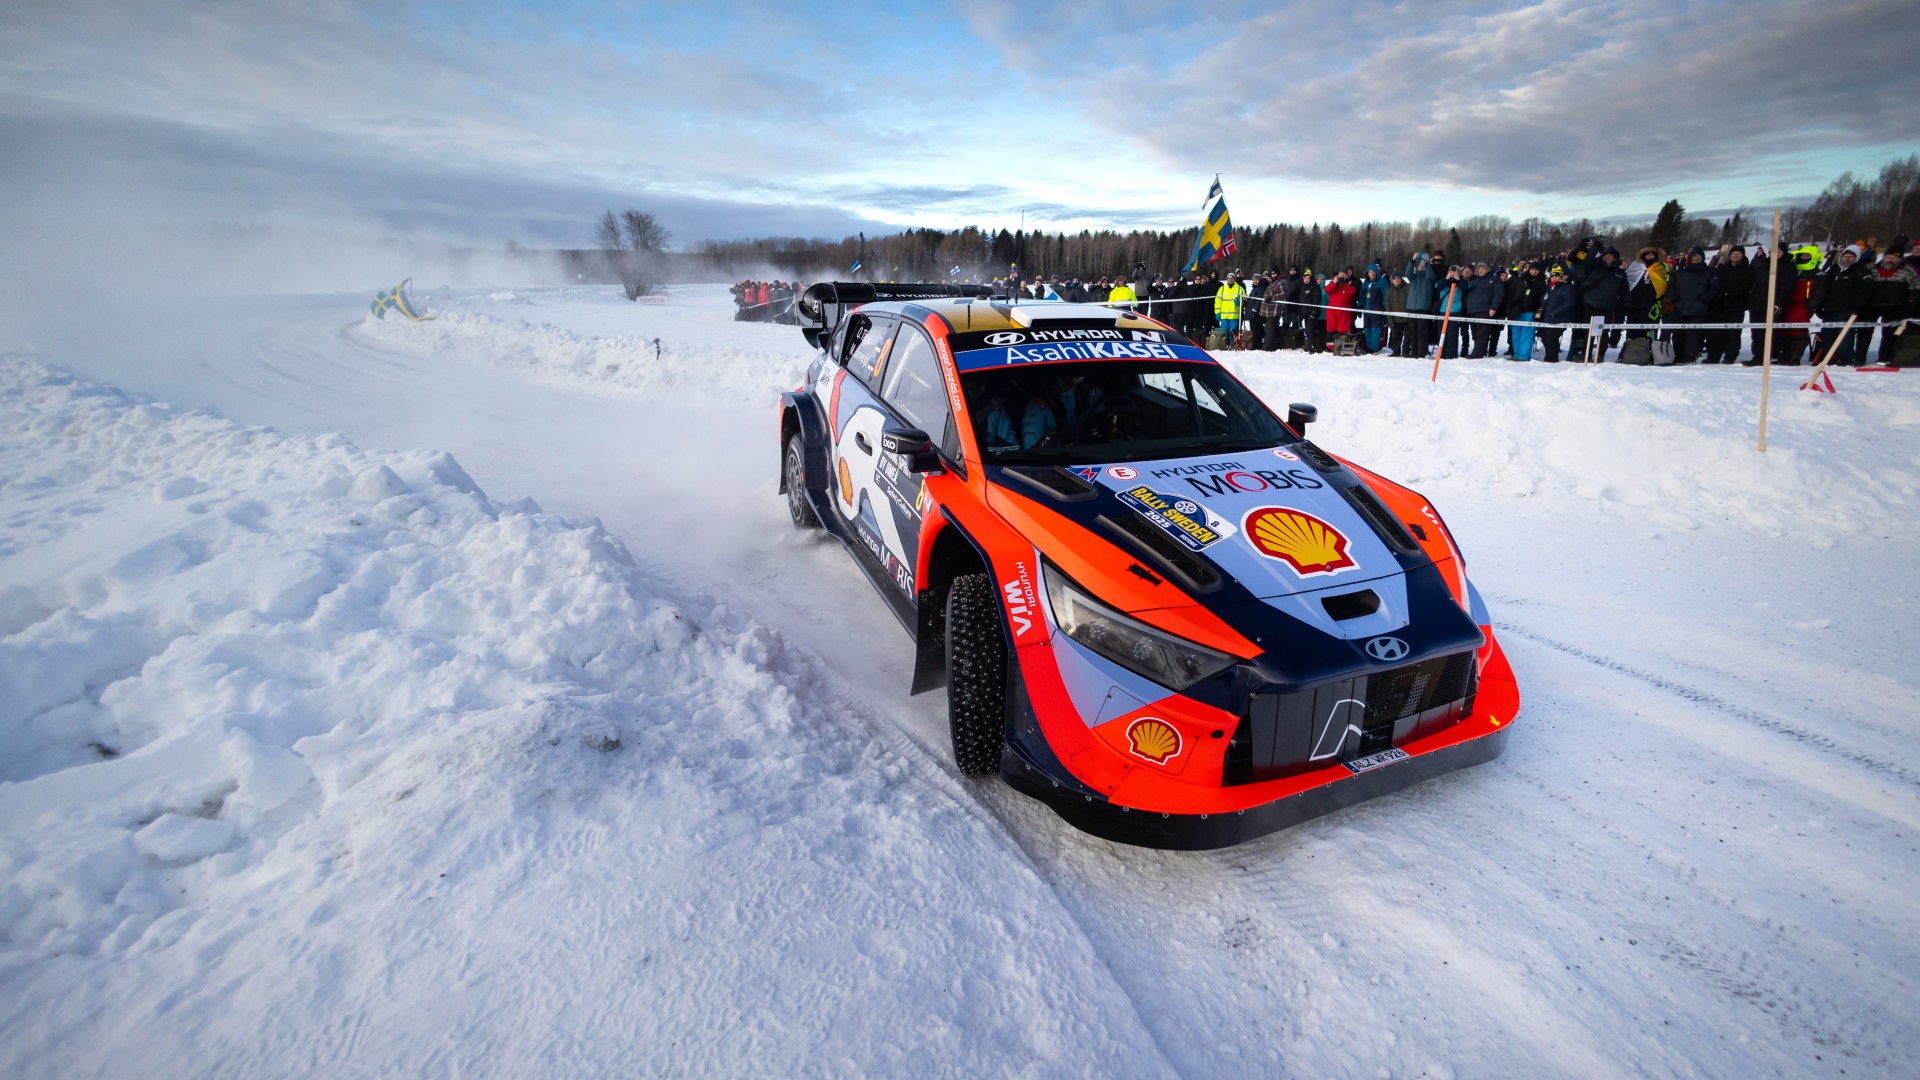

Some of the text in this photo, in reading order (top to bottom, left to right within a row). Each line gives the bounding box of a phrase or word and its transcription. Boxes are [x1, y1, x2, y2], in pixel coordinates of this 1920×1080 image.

[1030, 329, 1124, 341] HYUNDAI
[873, 338, 892, 377] 8
[937, 337, 962, 412] motorsport.hyundai.com
[1115, 468, 1131, 478] E
[1150, 462, 1246, 479] HYUNDAI
[1184, 469, 1323, 498] MOBIS
[1130, 487, 1217, 544] RALLY SWEDEN
[1144, 510, 1172, 529] 2025
[858, 525, 881, 558] HYUNDAI
[880, 544, 914, 600] MOBIS
[1015, 561, 1037, 607] HYUNDAI
